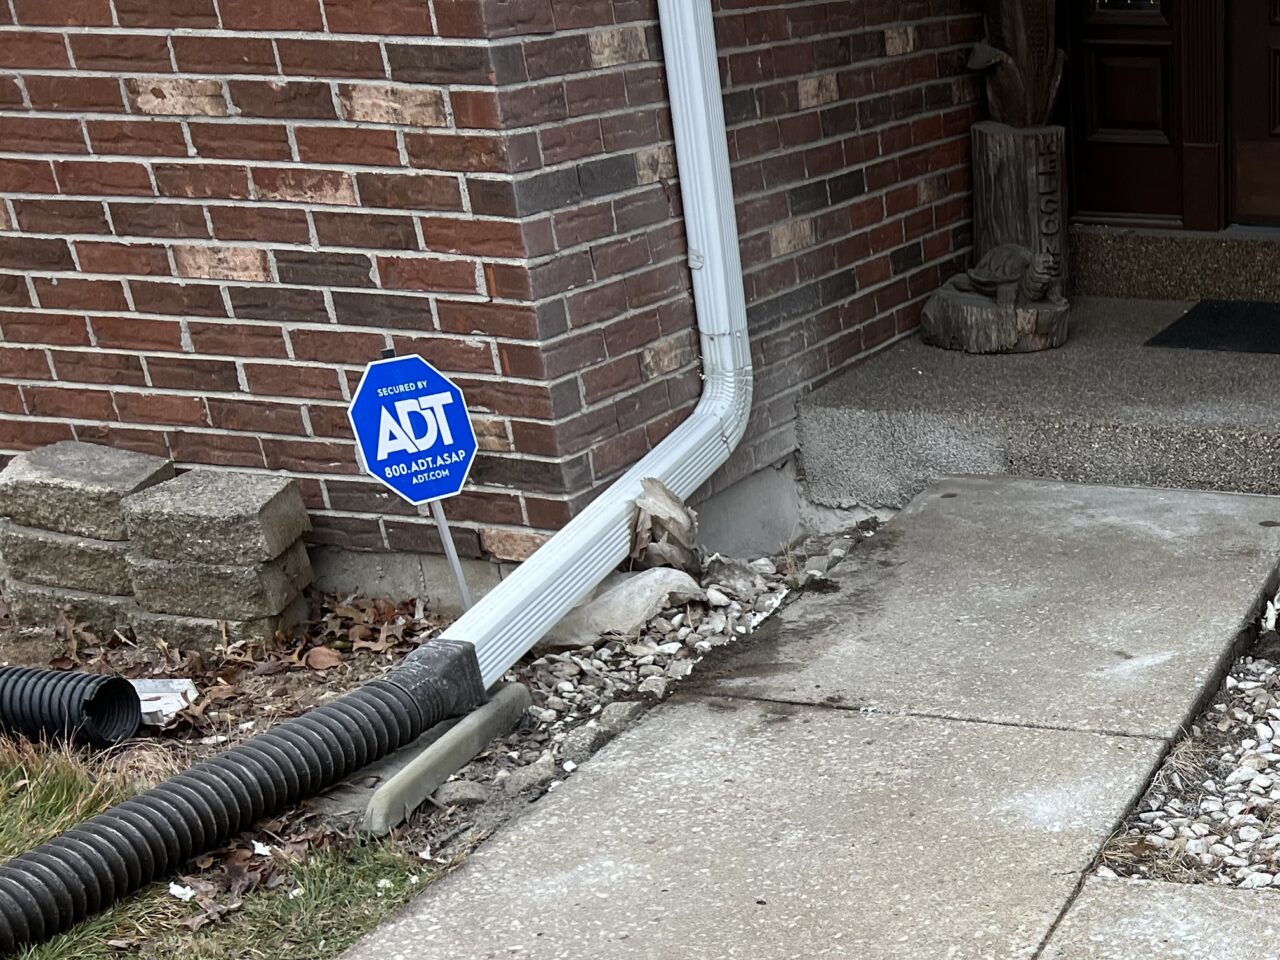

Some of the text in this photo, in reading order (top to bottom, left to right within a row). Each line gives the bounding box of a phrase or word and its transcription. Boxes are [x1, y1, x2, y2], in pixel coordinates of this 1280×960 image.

[377, 380, 428, 397] SECURED BY
[376, 391, 454, 461] ADT
[384, 449, 466, 478] 800.ADT.ASAP
[411, 469, 450, 485] ADT.COM
